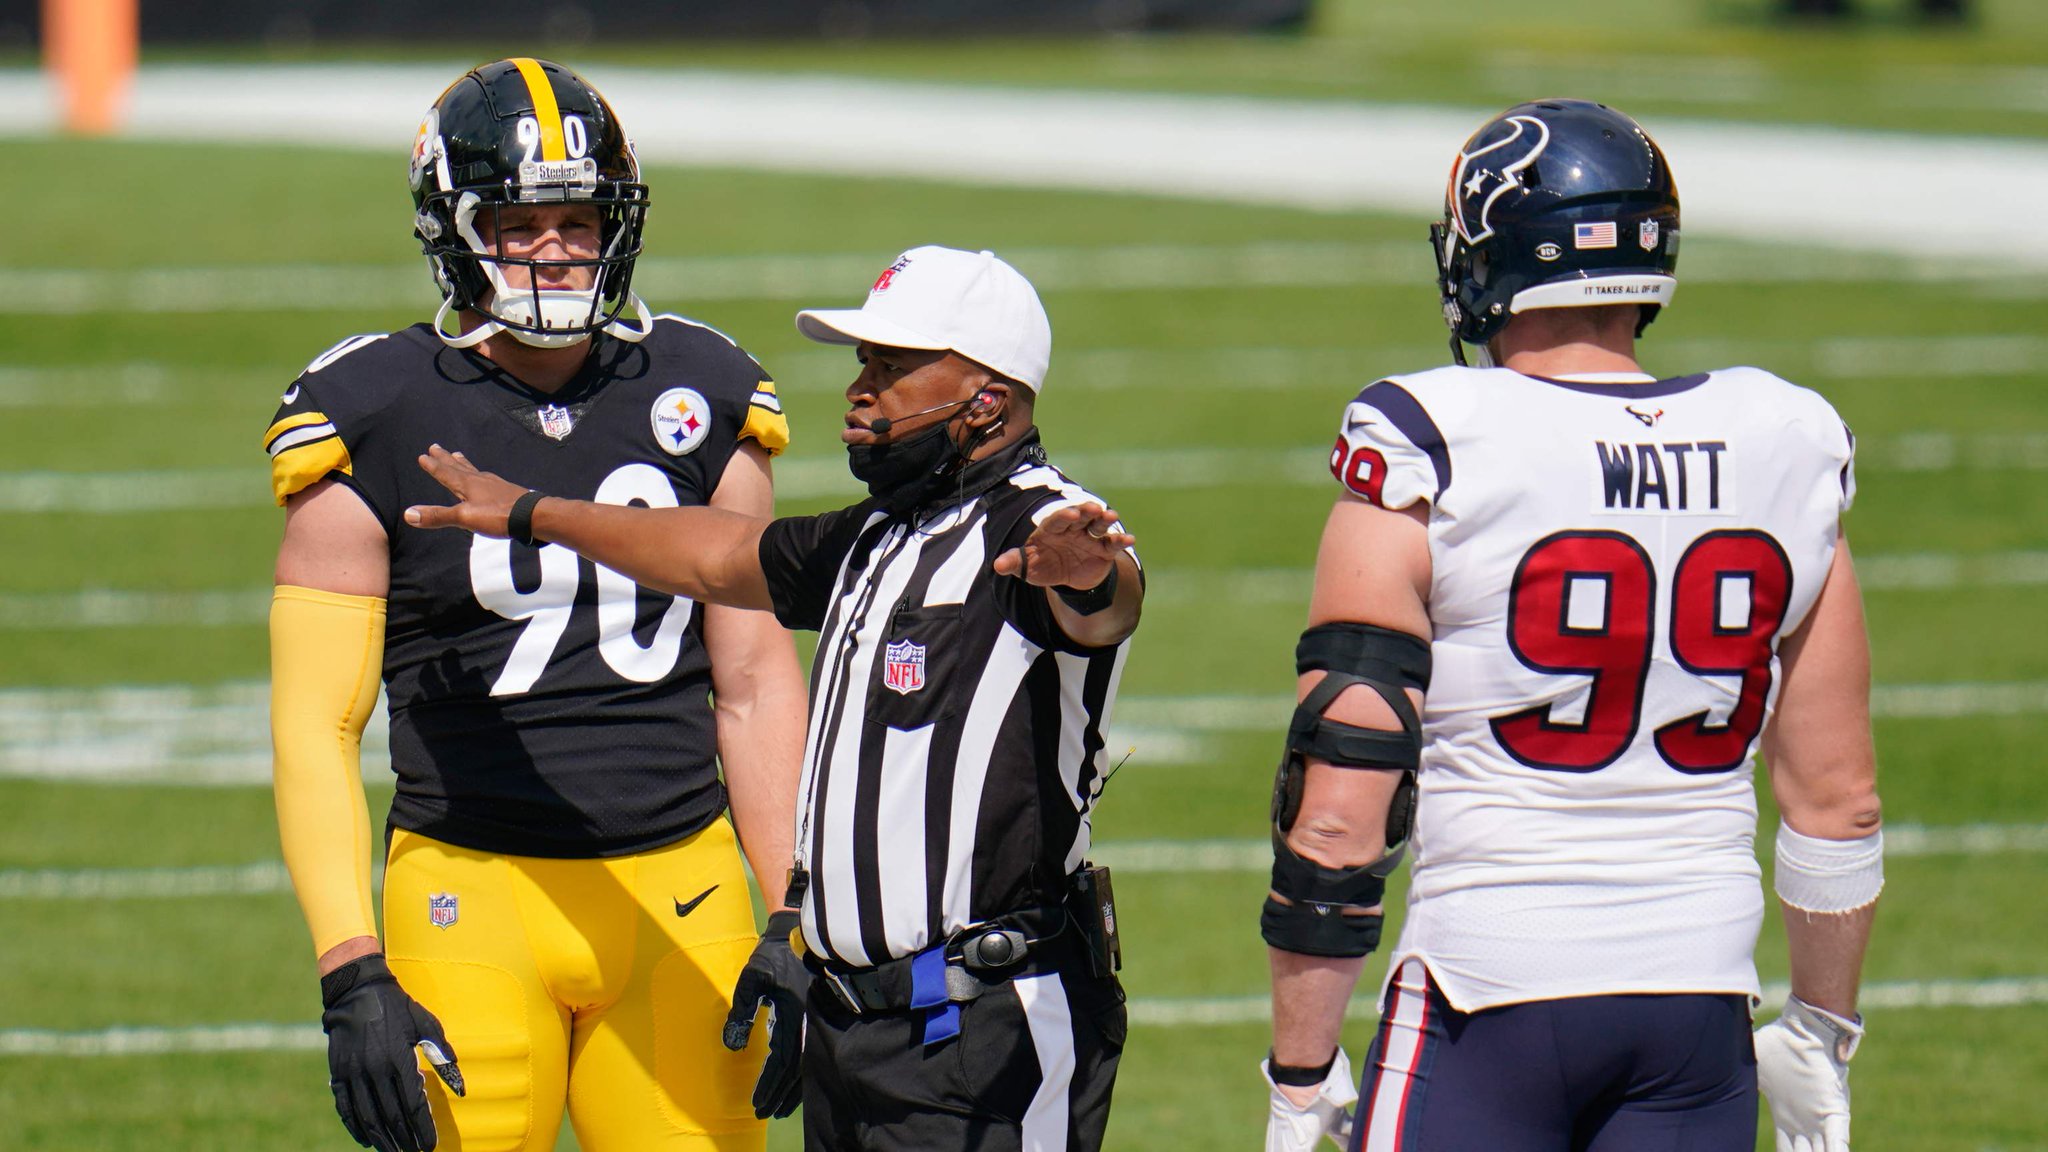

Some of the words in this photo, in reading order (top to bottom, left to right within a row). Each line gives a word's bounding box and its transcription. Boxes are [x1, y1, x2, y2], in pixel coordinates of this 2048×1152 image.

[517, 115, 588, 162] 90
[540, 164, 577, 179] Steelers
[1584, 286, 1594, 295] IT
[1596, 285, 1624, 295] TAKES
[1625, 285, 1639, 294] ALL
[1641, 285, 1650, 294] OF
[1651, 284, 1662, 293] US
[657, 414, 680, 424] Steelers
[1595, 440, 1727, 510] WATT
[470, 464, 694, 697] 90
[1489, 529, 1794, 774] 99
[888, 663, 922, 689] NFL
[434, 909, 454, 922] NFL
